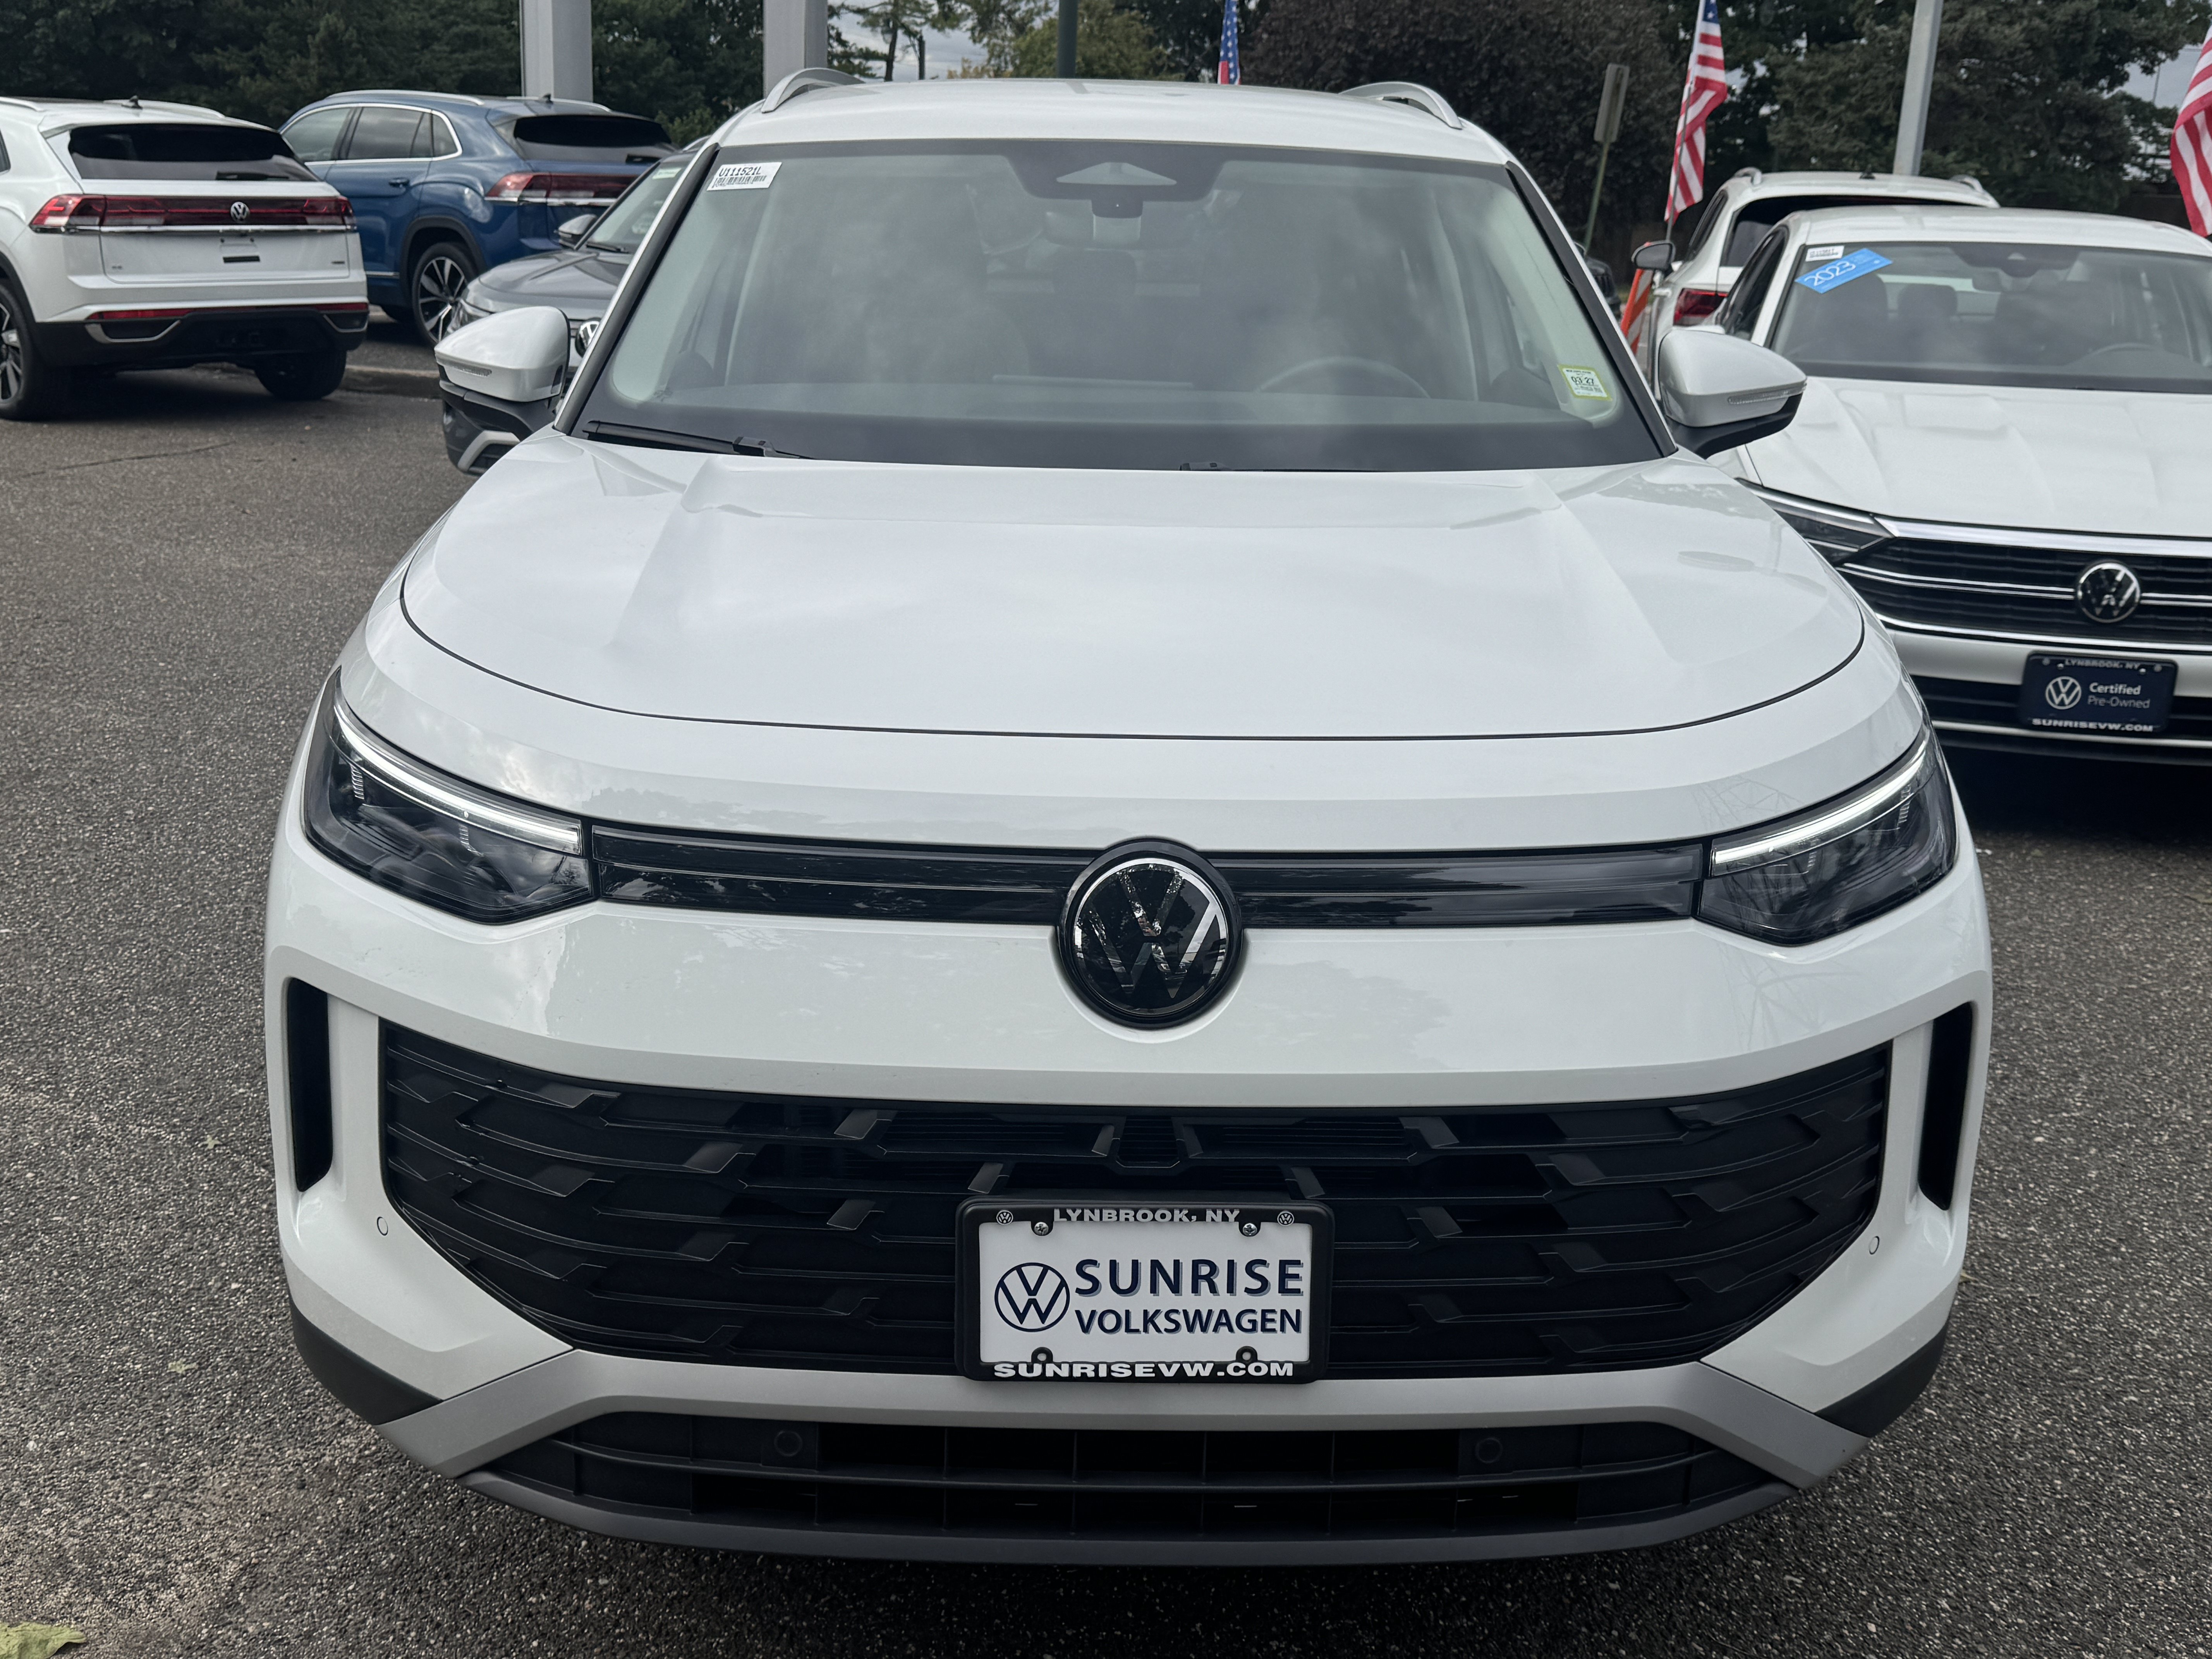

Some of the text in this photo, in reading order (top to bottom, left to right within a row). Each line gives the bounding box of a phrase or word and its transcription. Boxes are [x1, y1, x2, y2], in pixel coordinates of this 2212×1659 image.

[718, 166, 761, 177] U111521L
[1804, 260, 1856, 286] 2023
[2045, 676, 2082, 709] VW
[2089, 682, 2142, 695] Certified
[2087, 695, 2150, 709] Pre-Owned
[2032, 718, 2154, 732] SUNRISEVW.COM
[1074, 857, 1229, 1015] VW
[1053, 1208, 1240, 1223] LYNBROOK, NY
[1075, 1259, 1304, 1297] SUNRISE
[994, 1262, 1070, 1333] VW
[1075, 1309, 1302, 1335] VOLKSWAGEN
[994, 1363, 1293, 1378] SUNRISEVW.COM
